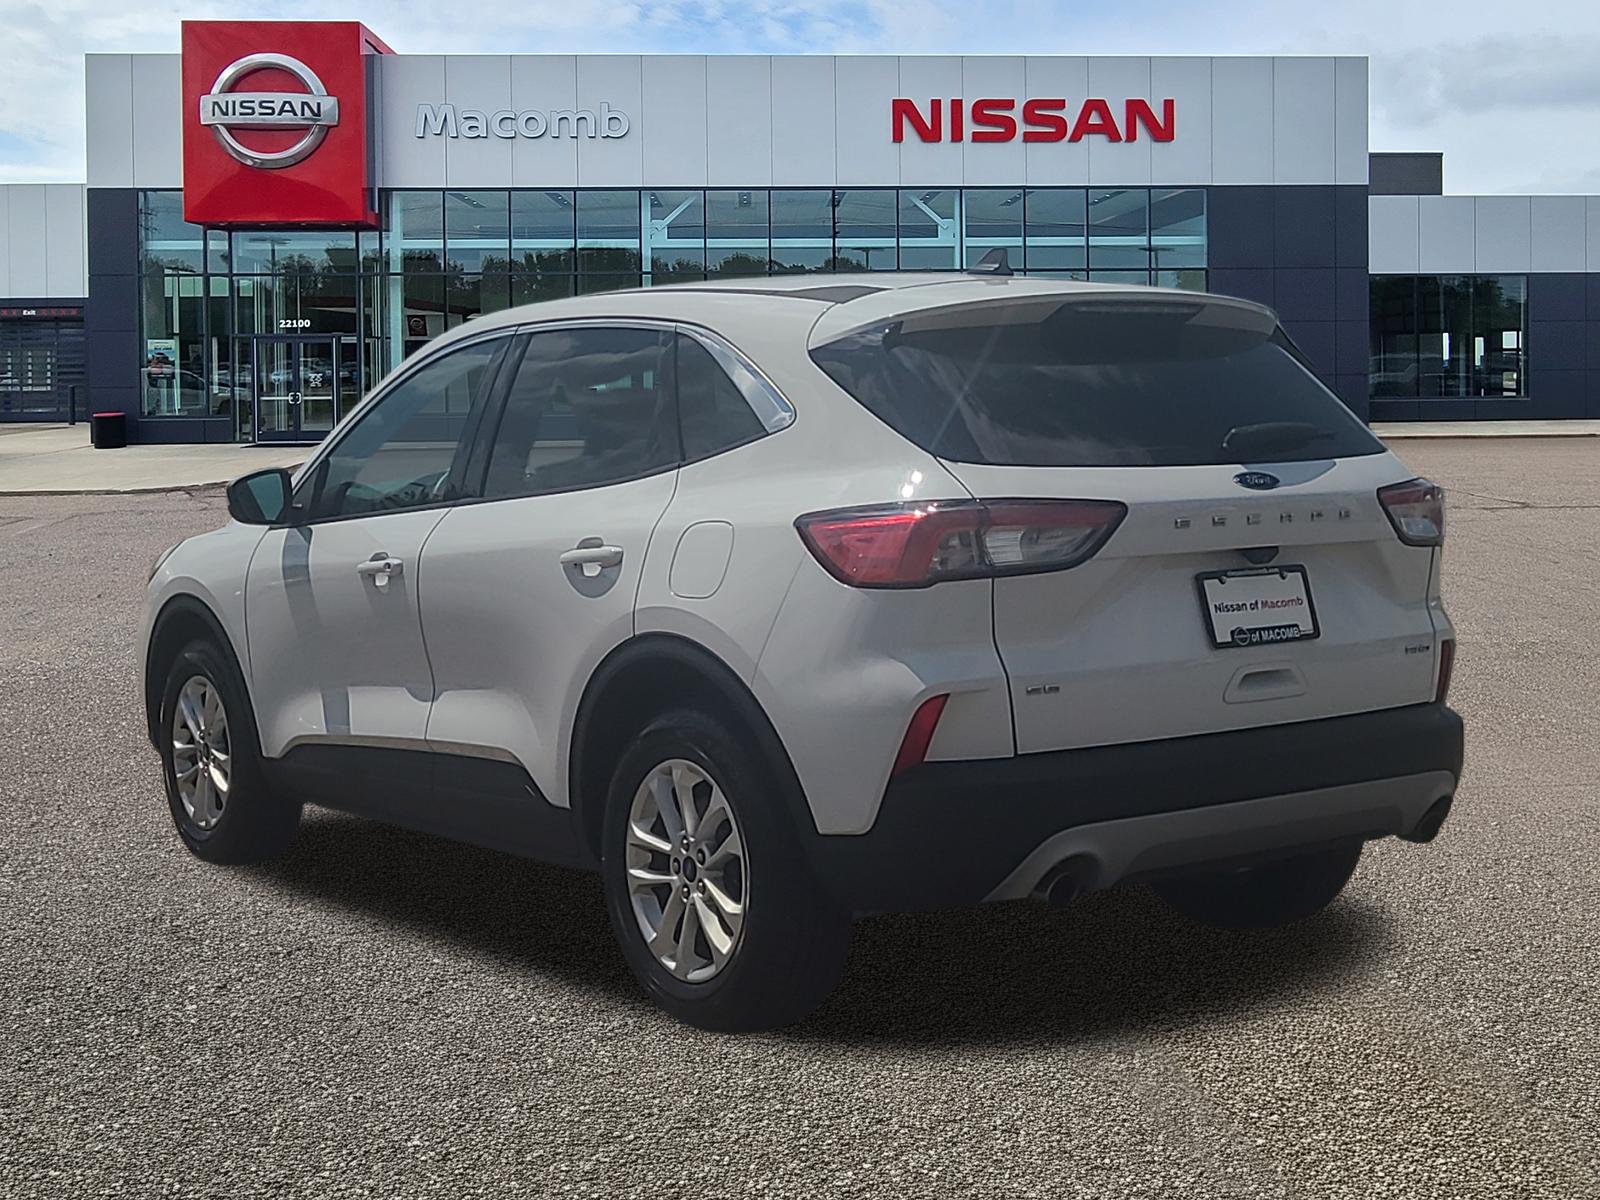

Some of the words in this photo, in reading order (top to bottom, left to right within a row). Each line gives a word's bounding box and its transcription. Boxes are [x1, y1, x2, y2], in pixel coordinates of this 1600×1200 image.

[211, 100, 322, 118] NISSAN
[415, 102, 630, 139] Macomb
[892, 98, 1175, 143] NISSAN
[279, 319, 311, 328] 22100
[1213, 601, 1248, 614] Nissan
[1249, 599, 1260, 611] of
[1260, 596, 1304, 610] Macomb
[1260, 626, 1301, 641] MACOMB
